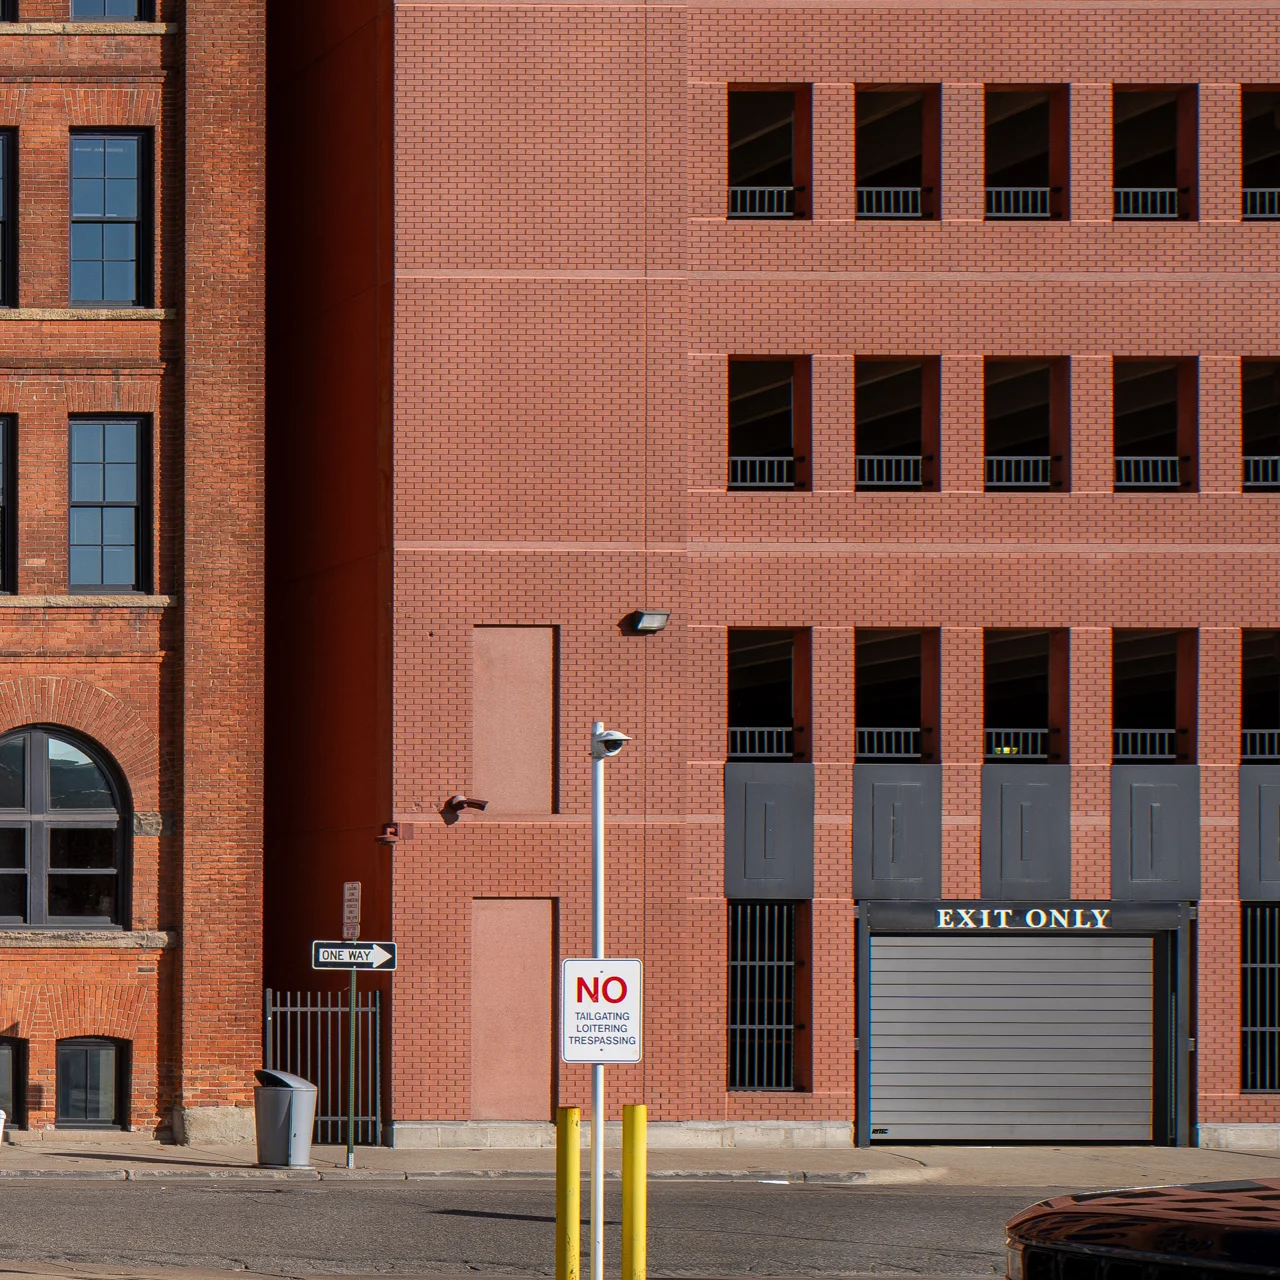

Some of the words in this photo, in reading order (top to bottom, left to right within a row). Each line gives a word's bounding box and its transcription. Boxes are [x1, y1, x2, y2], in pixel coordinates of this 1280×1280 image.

[937, 909, 1013, 928] EXIT
[1025, 909, 1111, 928] ONLY
[322, 950, 344, 960] ONE
[348, 950, 371, 961] WAY
[576, 976, 627, 1004] NO
[575, 1012, 630, 1021] TAILGATING
[576, 1024, 628, 1033] LOITERING
[568, 1036, 636, 1045] TRESPASSING
